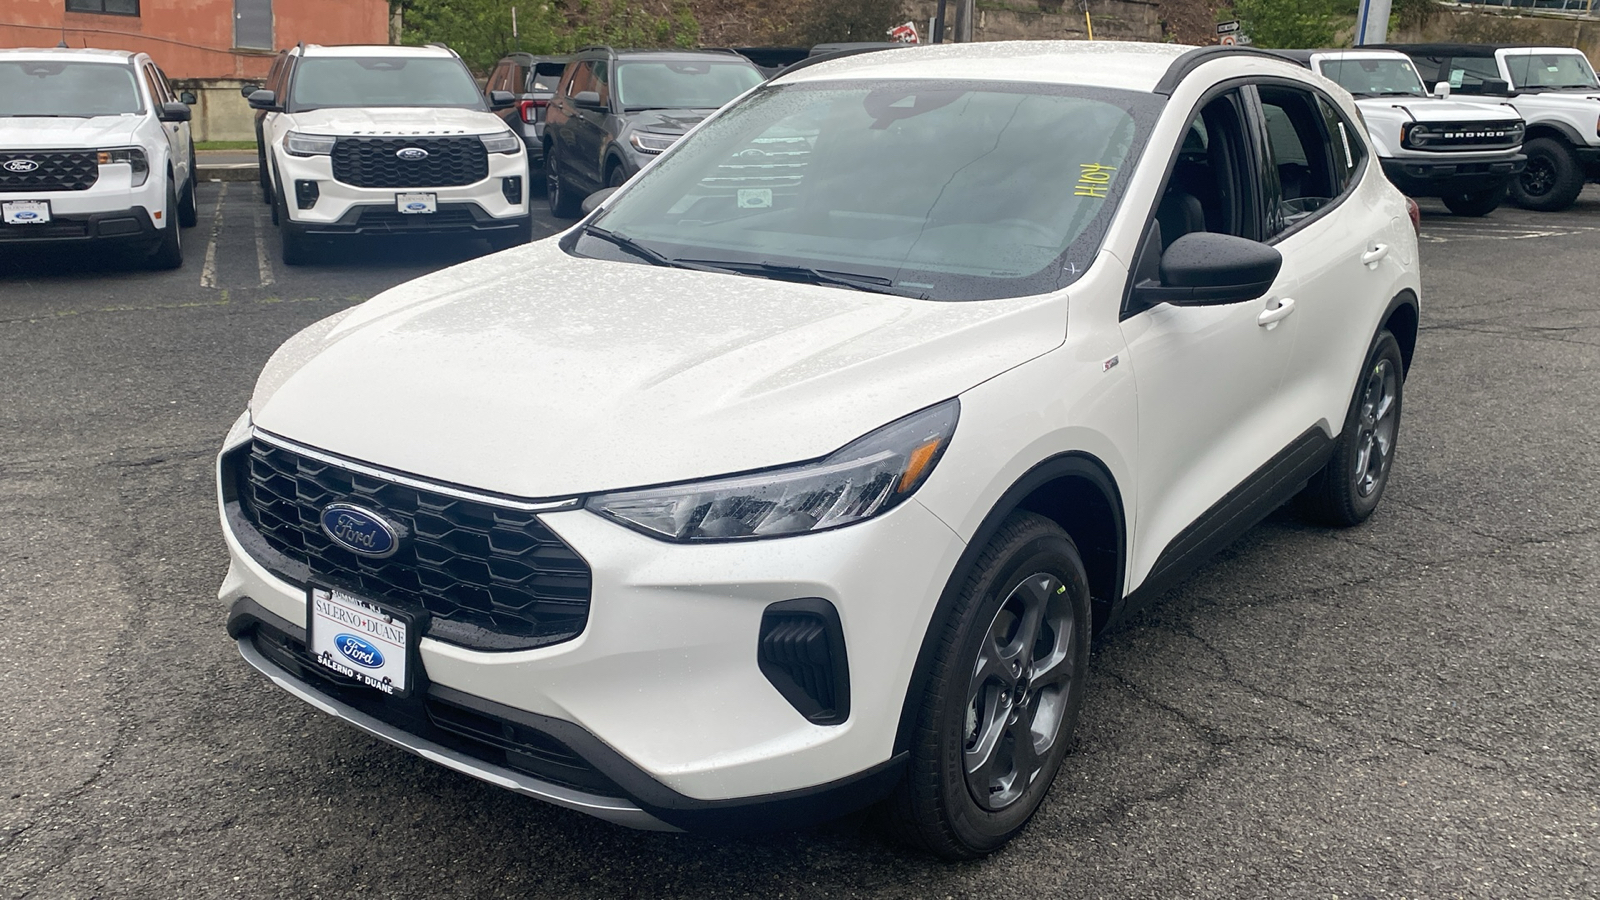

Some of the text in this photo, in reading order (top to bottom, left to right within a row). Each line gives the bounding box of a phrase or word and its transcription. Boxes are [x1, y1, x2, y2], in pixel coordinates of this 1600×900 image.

[1444, 131, 1505, 139] BRONCO
[10, 161, 32, 170] Ford
[1073, 162, 1117, 198] H104
[334, 513, 377, 548] Ford
[315, 599, 405, 645] SALERNO DUANE
[343, 638, 374, 664] Ford
[317, 655, 394, 695] SALERNO DUANE
